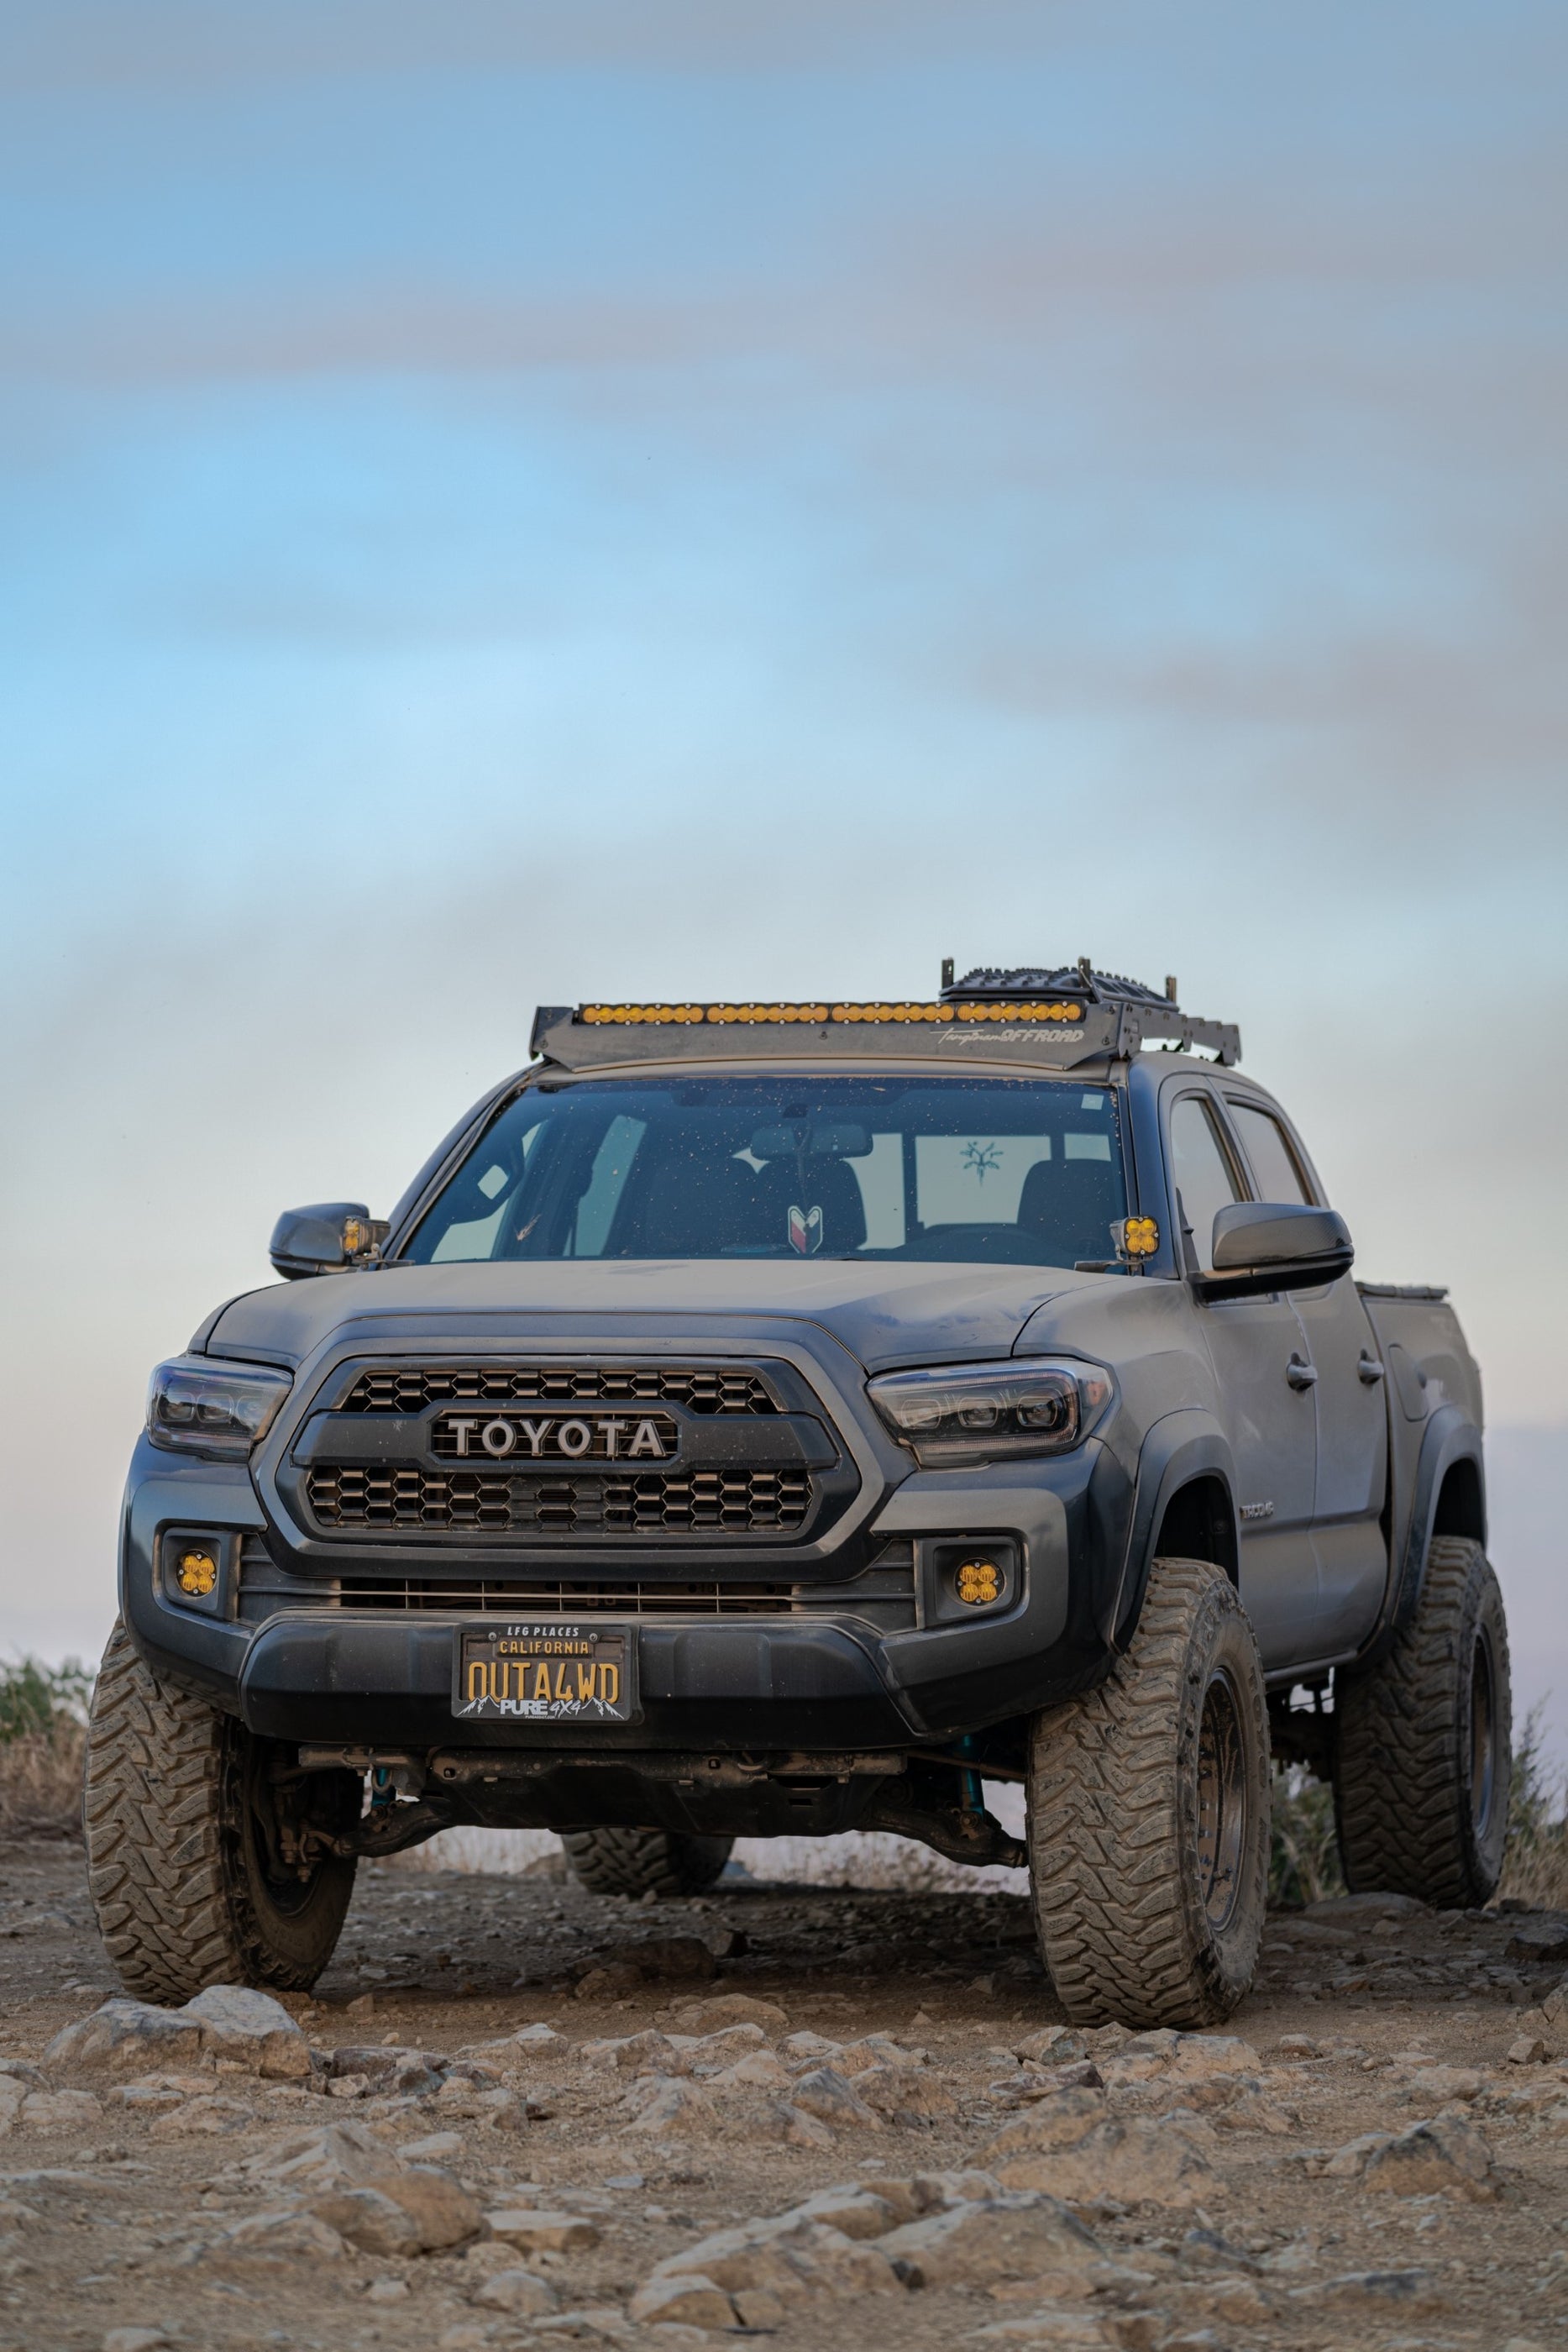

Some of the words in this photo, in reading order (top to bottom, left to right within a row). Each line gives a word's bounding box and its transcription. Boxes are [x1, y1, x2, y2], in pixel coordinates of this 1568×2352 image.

[1000, 1029, 1084, 1042] OFFROAD
[448, 1417, 667, 1457] TOYOTA
[507, 1626, 529, 1636] LFG
[533, 1626, 579, 1637] PLACES
[499, 1641, 589, 1655] CALIFORNIA
[468, 1662, 619, 1704] OUTA4WD
[500, 1699, 548, 1715] PURE
